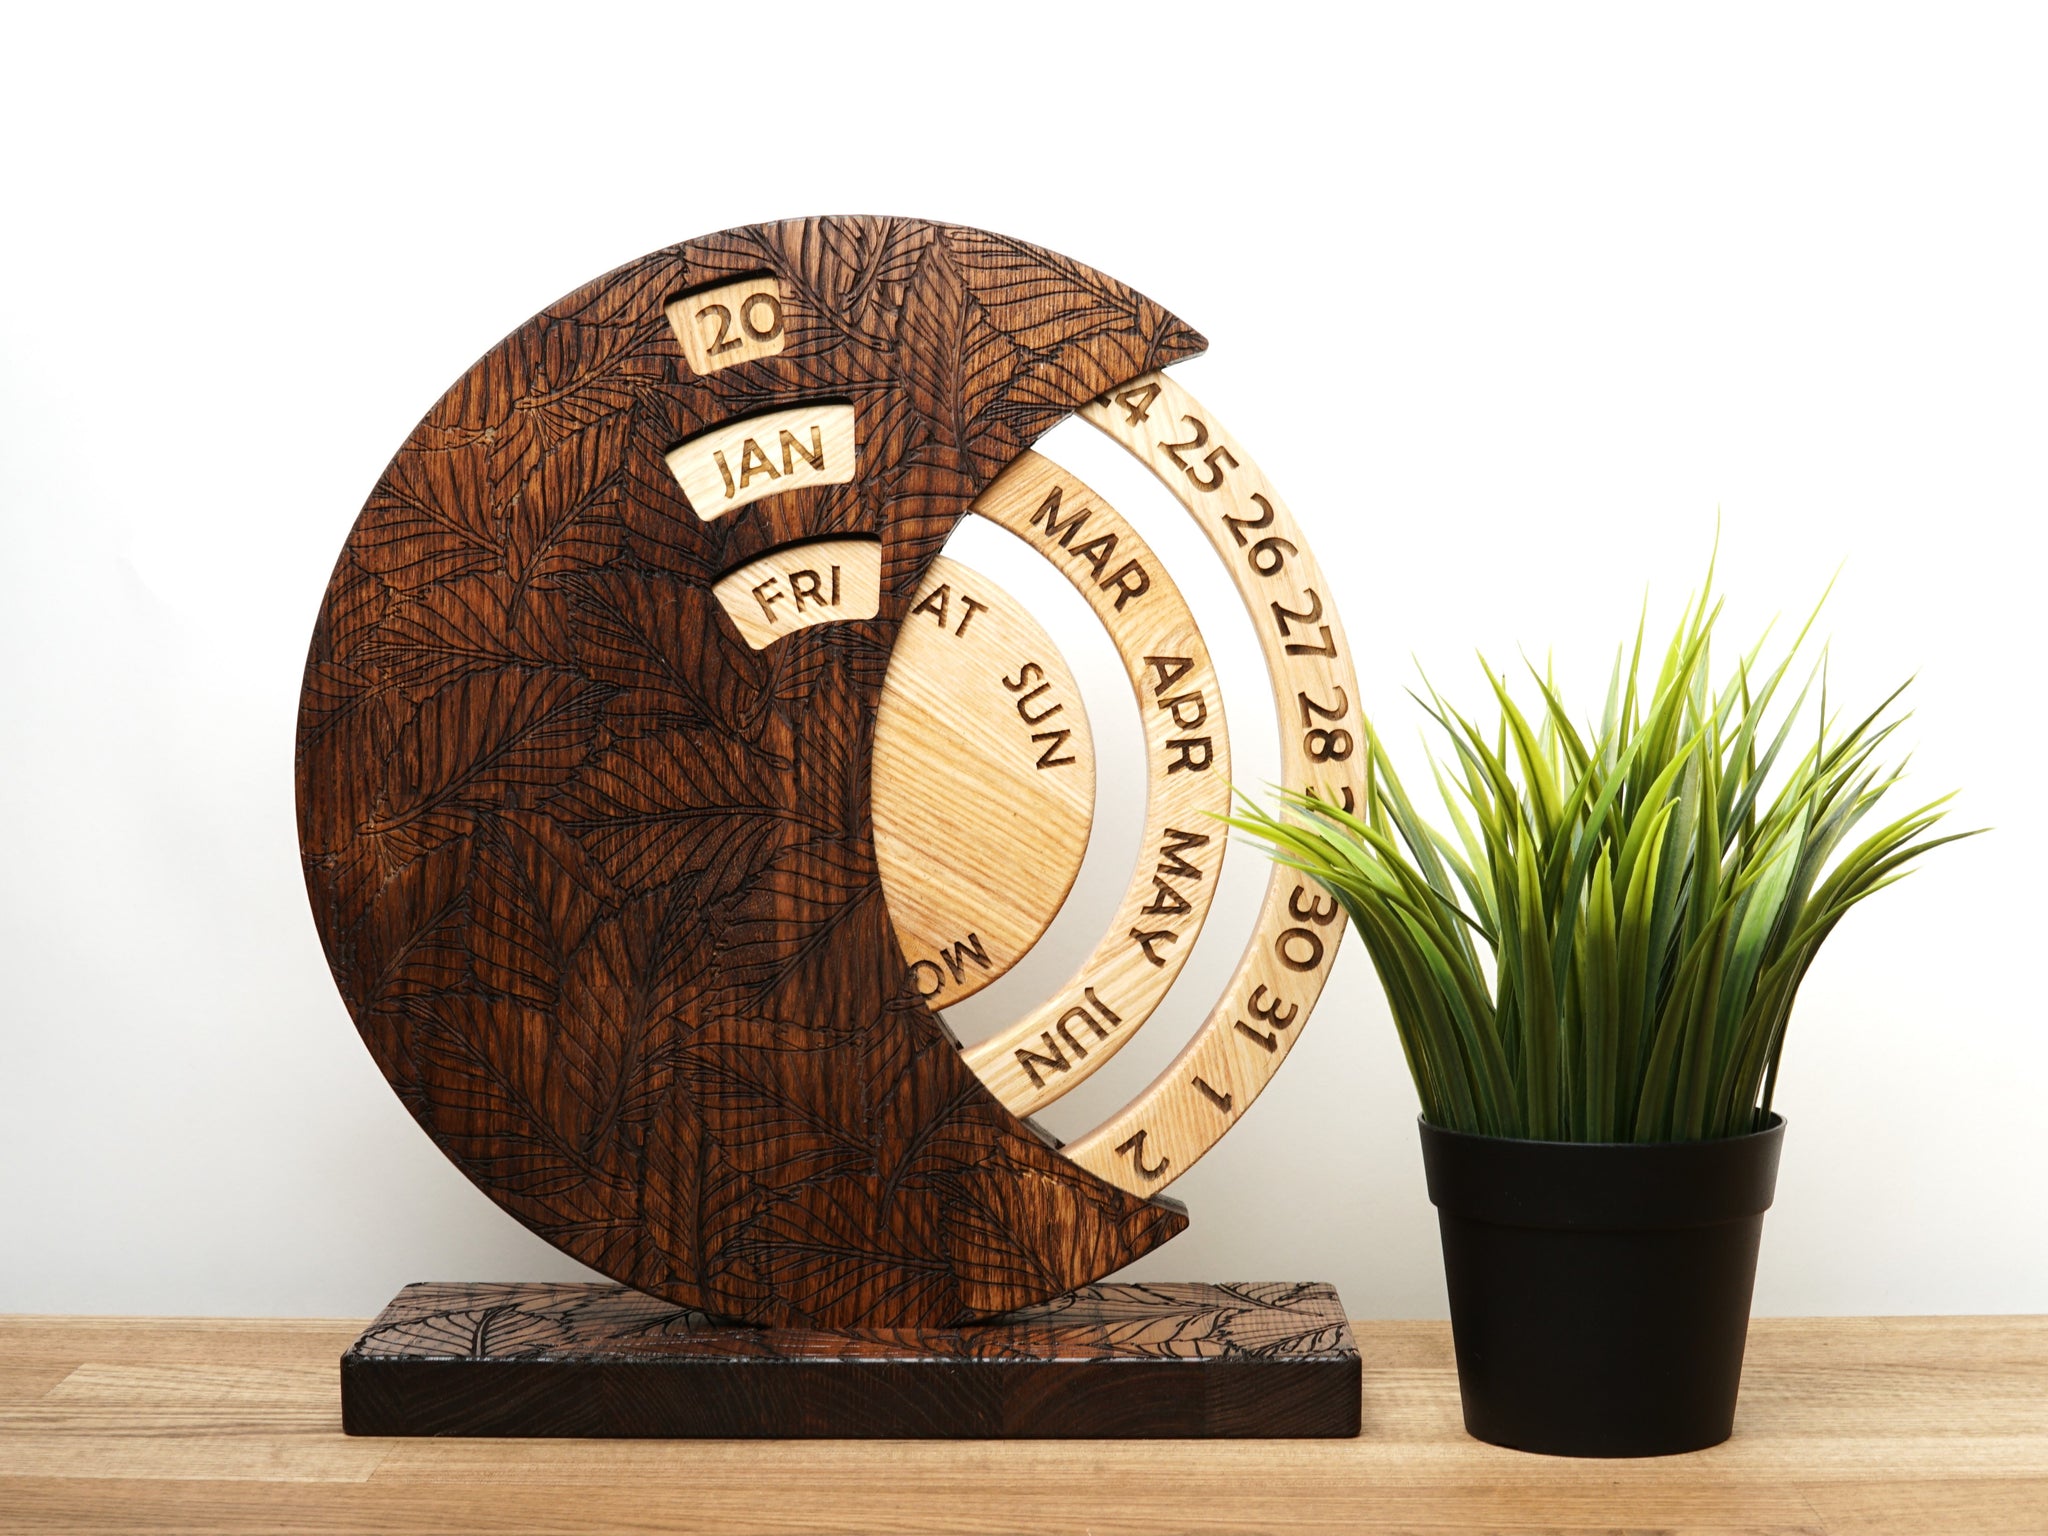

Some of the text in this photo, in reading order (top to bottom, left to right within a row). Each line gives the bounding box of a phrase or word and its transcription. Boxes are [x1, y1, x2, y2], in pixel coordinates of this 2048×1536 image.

[695, 292, 783, 357] 20
[1096, 381, 1162, 428] 4
[713, 425, 826, 500] JAN
[1157, 414, 1240, 493] 25
[1028, 485, 1151, 614] MAR
[1221, 492, 1299, 578] 26
[752, 564, 841, 625] FRI
[911, 583, 989, 639] AT
[1271, 587, 1338, 660] 27
[1001, 661, 1076, 771] SUN
[1143, 654, 1214, 775] APR
[1297, 684, 1355, 765] 28
[1128, 827, 1211, 969] MAY
[1274, 883, 1339, 973] 30
[909, 932, 993, 1000] MO
[1013, 985, 1123, 1090] JUN
[1233, 983, 1299, 1054] 31
[1190, 1075, 1233, 1115] 1
[1114, 1128, 1171, 1182] 2
